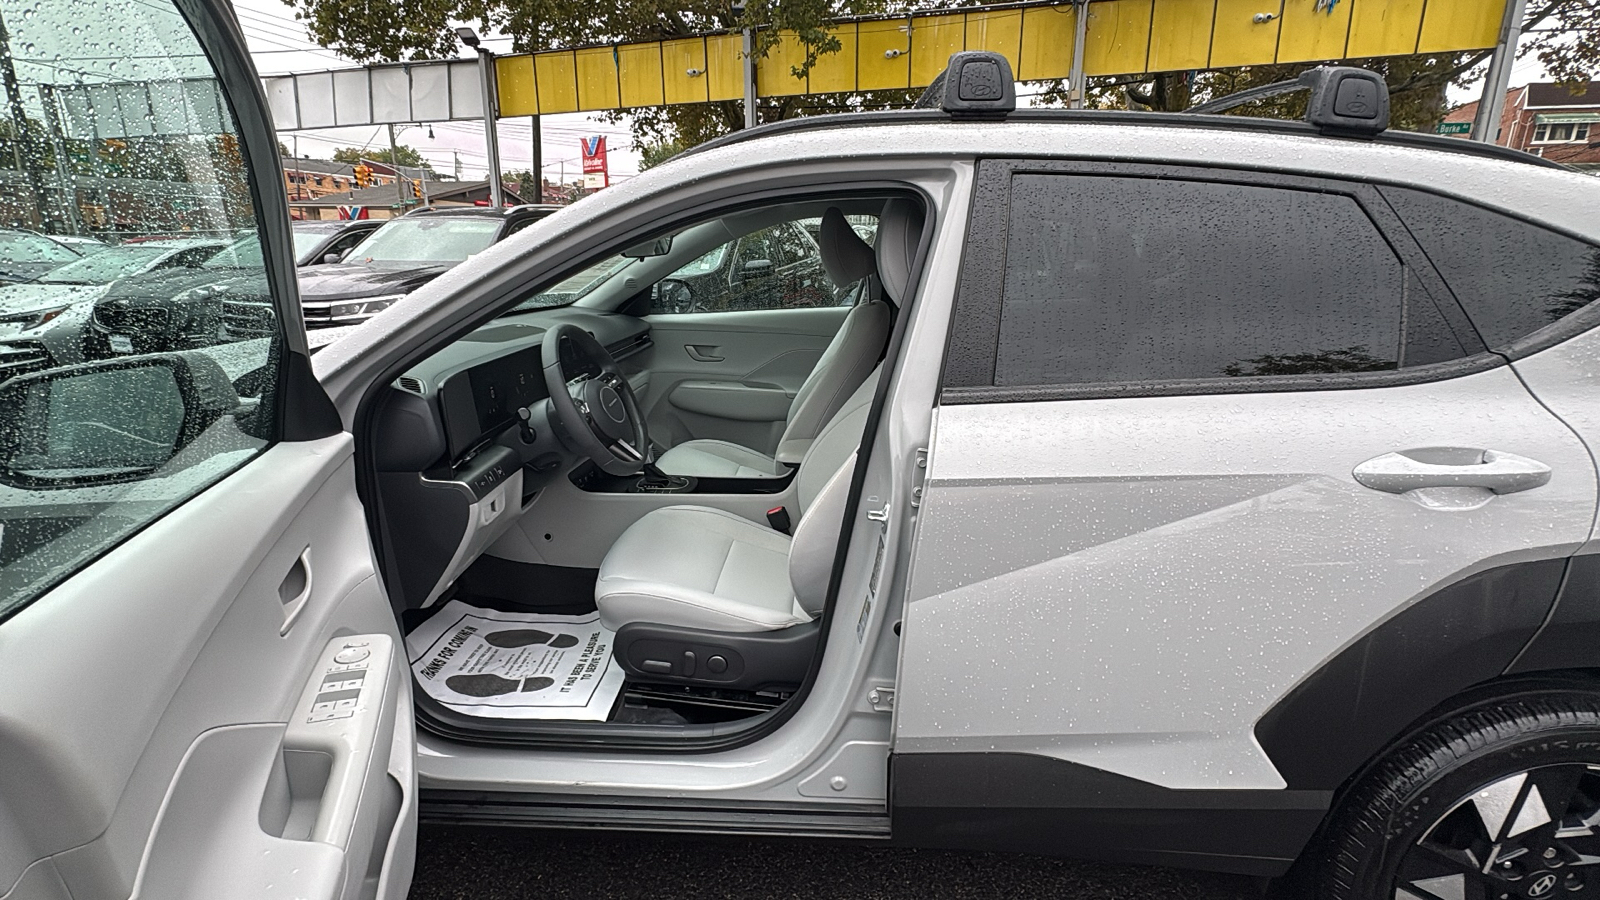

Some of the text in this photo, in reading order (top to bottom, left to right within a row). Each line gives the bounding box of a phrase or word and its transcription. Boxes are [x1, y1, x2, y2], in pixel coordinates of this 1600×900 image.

[420, 658, 447, 681] THANKS
[438, 646, 458, 661] FOR
[448, 629, 473, 648] COMING
[464, 625, 479, 634] IN
[581, 631, 601, 658] PLEASURE
[570, 663, 587, 676] BEEN
[580, 644, 607, 681] TO SERVE YOU
[563, 676, 578, 687] HAS
